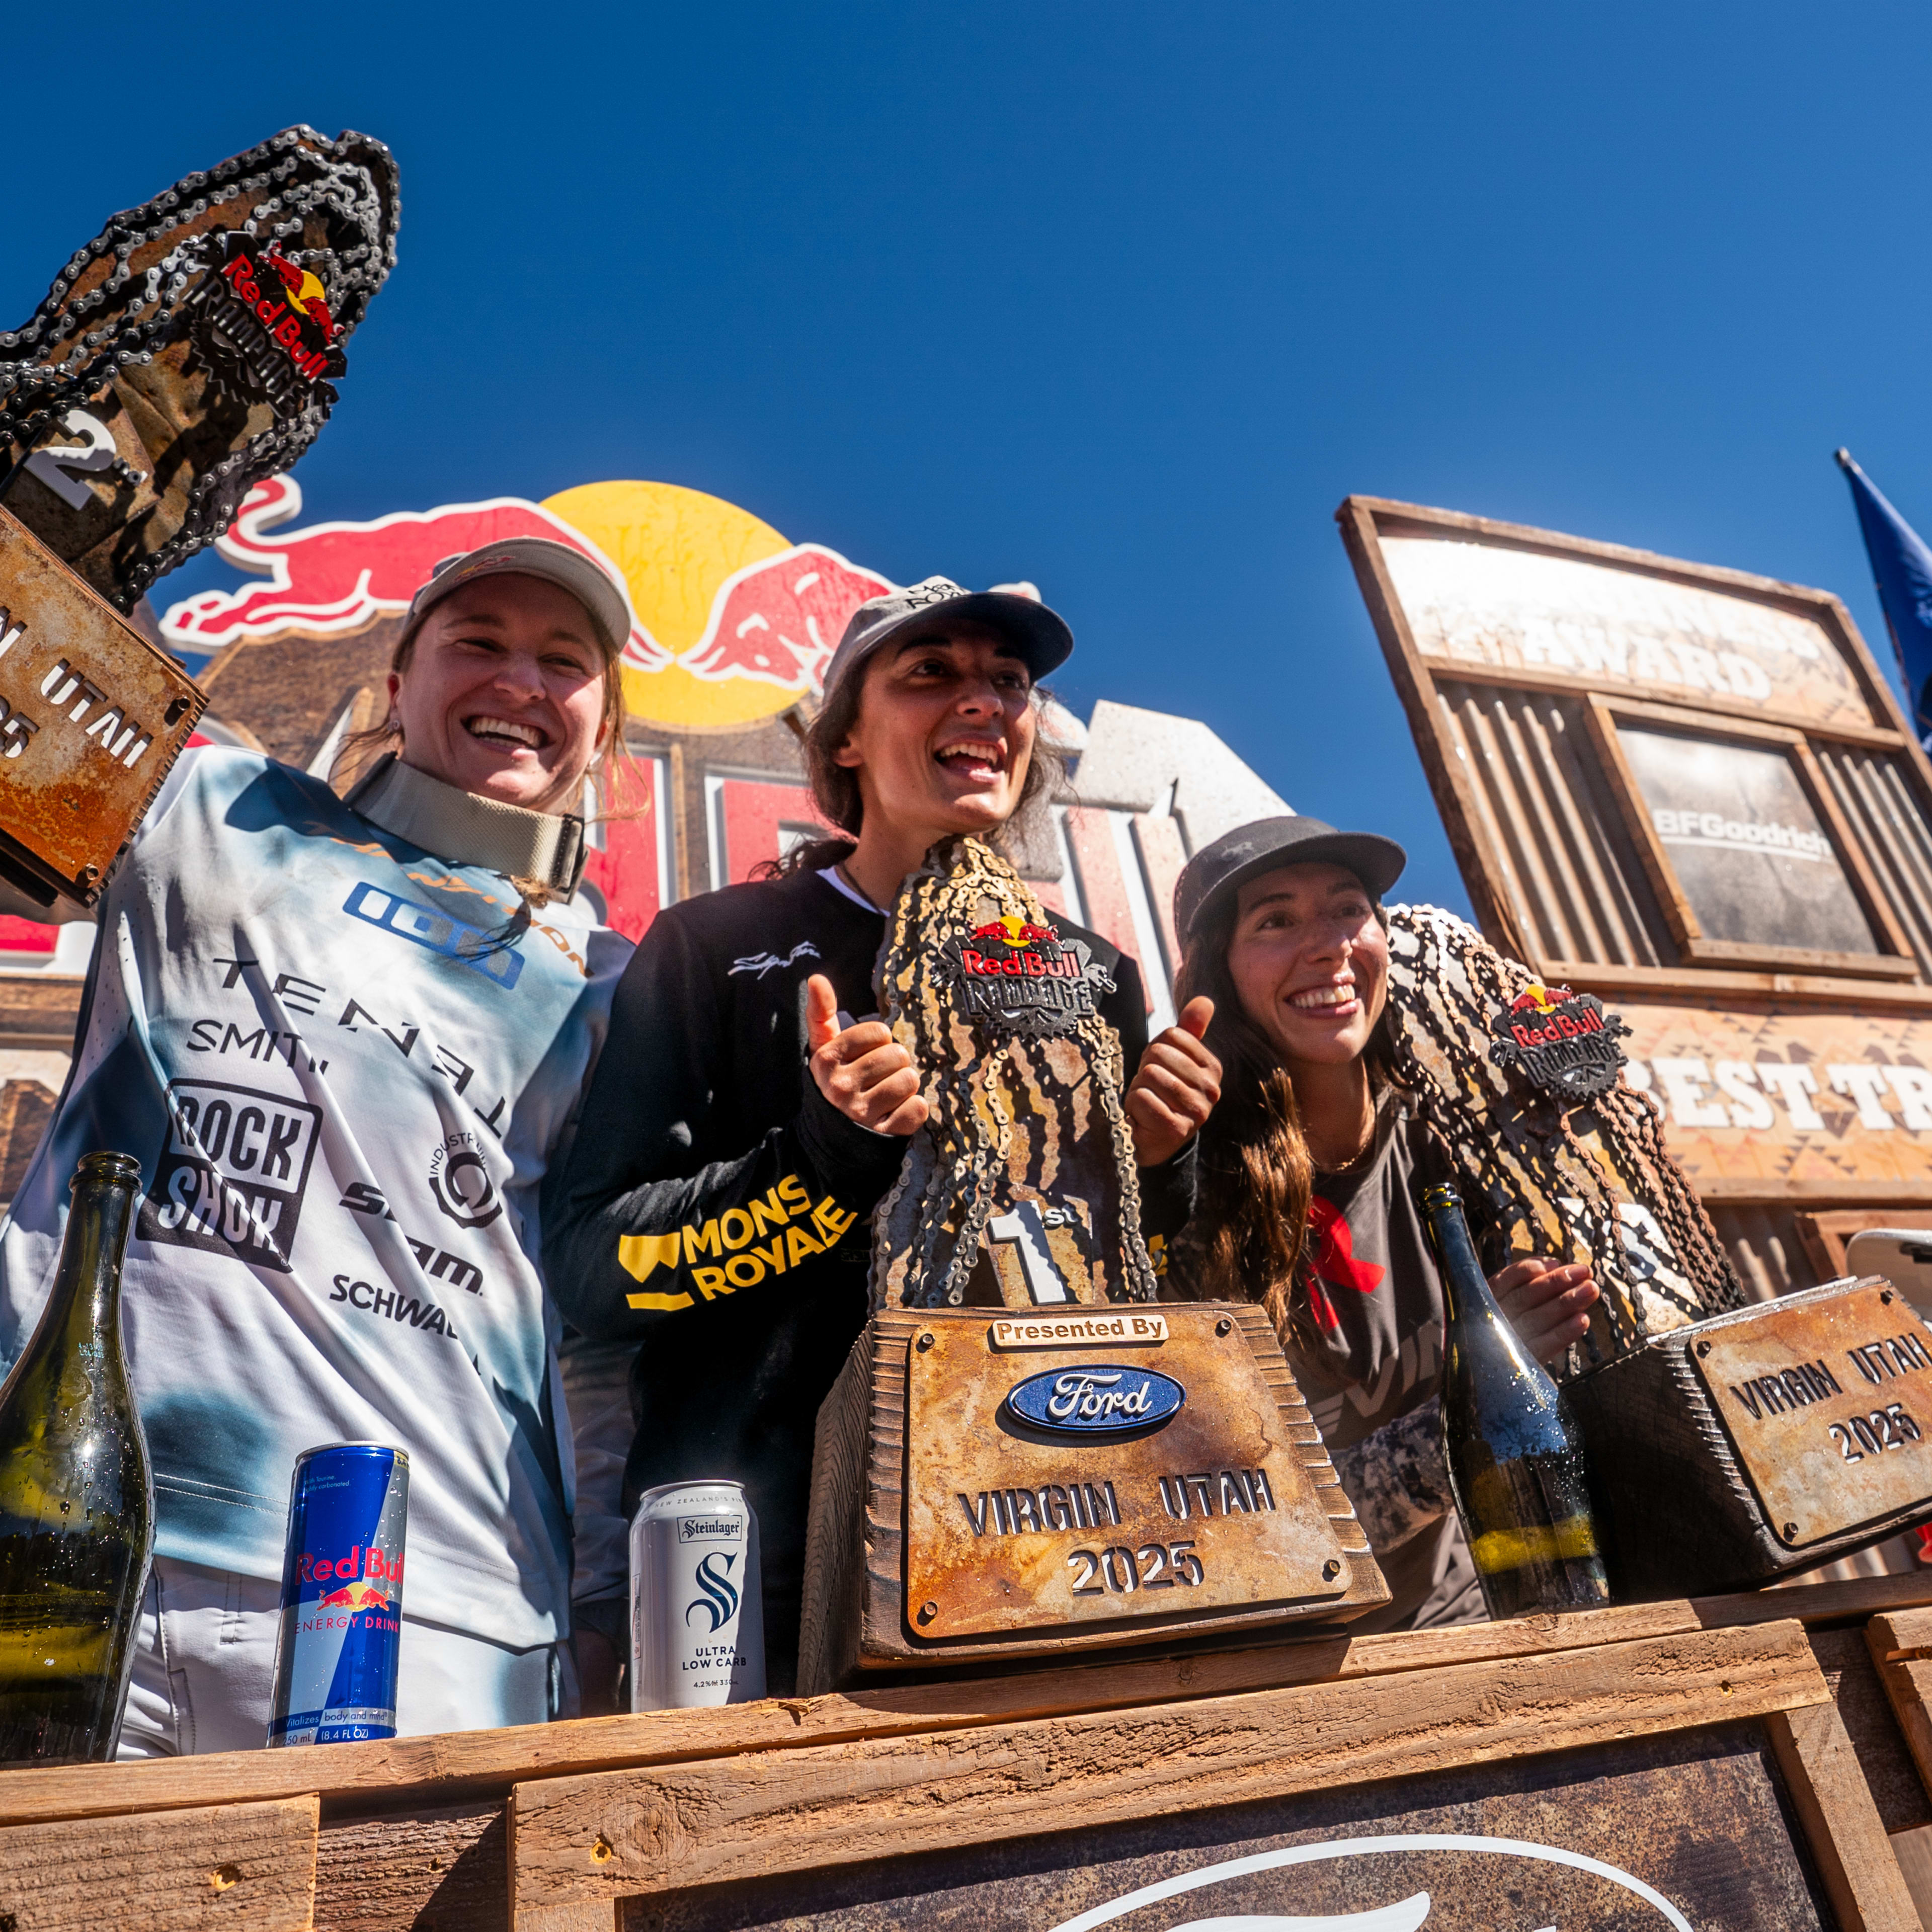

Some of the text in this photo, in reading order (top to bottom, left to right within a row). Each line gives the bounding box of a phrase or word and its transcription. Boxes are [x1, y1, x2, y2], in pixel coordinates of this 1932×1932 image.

[222, 254, 329, 379] Red Bull
[1519, 617, 1773, 700] AWARD
[41, 658, 153, 768] UTAH
[1653, 809, 1831, 855] BFGoodrich
[962, 949, 1080, 977] Red Bull
[963, 977, 1095, 1016] RAMPAGE
[1510, 1007, 1605, 1048] Red Bull
[176, 1095, 302, 1181] ROCK
[682, 1174, 812, 1264] MONS
[691, 1195, 858, 1301] ROYALE
[990, 1199, 1078, 1306] 1st
[329, 1274, 458, 1340] SCHWAL
[996, 1318, 1162, 1340] Presented By
[1049, 1373, 1153, 1419] Ford
[1729, 1332, 1932, 1420] VIRGIN UTAH
[1828, 1402, 1921, 1465] 2025
[677, 1496, 728, 1504] ZEALAND'S
[957, 1468, 1276, 1537] VIRGIN UTAH
[682, 1519, 740, 1539] Steinlager
[295, 1545, 360, 1585] Red
[1067, 1540, 1205, 1597] 2025
[294, 1616, 399, 1635] ENERGY DRINK
[682, 1657, 747, 1670] LOW CARB
[696, 1646, 735, 1657] ULTRA
[282, 1735, 297, 1746] 250
[321, 1729, 339, 1740] (8.4
[342, 1729, 351, 1739] FL
[286, 1716, 319, 1728] Vitalizes
[325, 1711, 348, 1723] body
[351, 1710, 366, 1720] and
